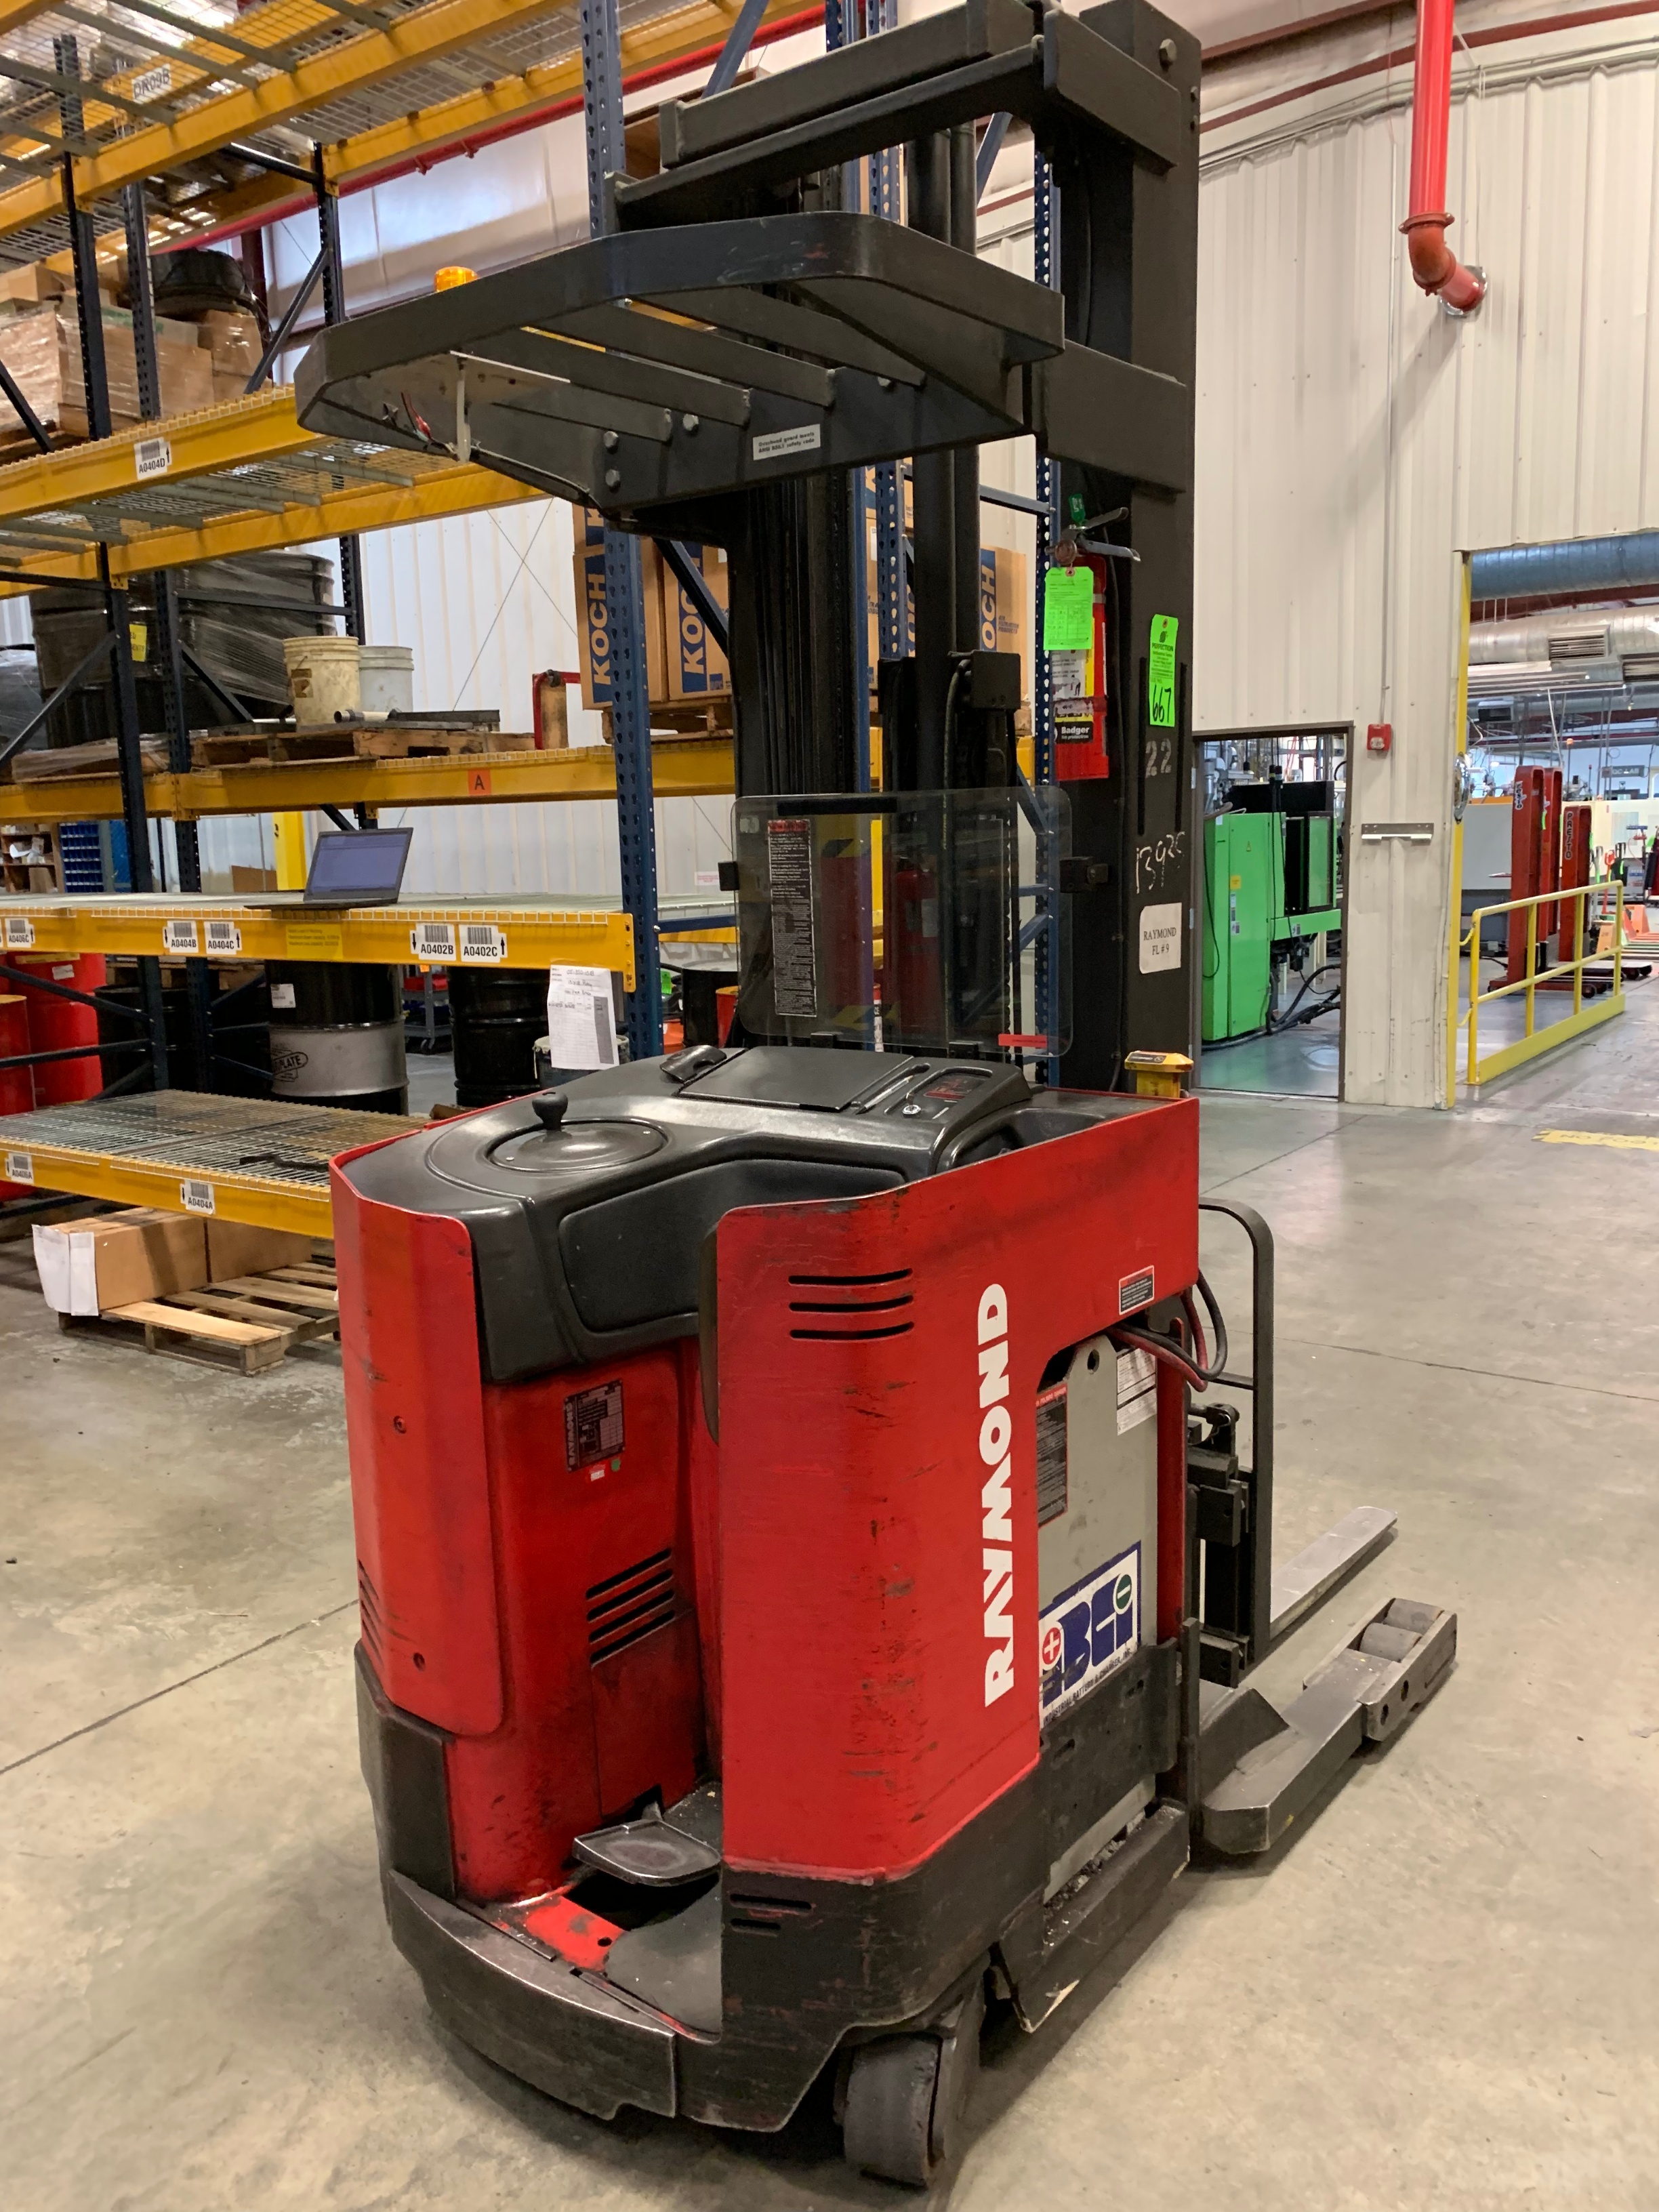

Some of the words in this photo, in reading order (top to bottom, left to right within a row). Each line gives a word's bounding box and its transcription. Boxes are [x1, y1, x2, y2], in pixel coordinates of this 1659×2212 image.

[139, 457, 165, 474] A0404D
[588, 573, 611, 685] KOCH
[1152, 642, 1174, 651] PERFECTION
[1153, 684, 1172, 723] 667
[1061, 726, 1090, 735] Badger
[1145, 737, 1172, 778] 22
[474, 775, 486, 791] A
[1565, 812, 1574, 859] PRESTO
[1143, 926, 1177, 941] RAYMOND
[171, 939, 197, 948] A0404B
[208, 940, 234, 949] A0404C
[421, 944, 454, 955] A0402B
[1152, 944, 1160, 956] FL
[464, 946, 497, 957] A0402C
[188, 1197, 213, 1210] A0404A
[978, 1283, 1015, 1708] RAYMOND
[1044, 1696, 1073, 1726] INDUSTRIAL
[1073, 1679, 1094, 1702] BATTERY
